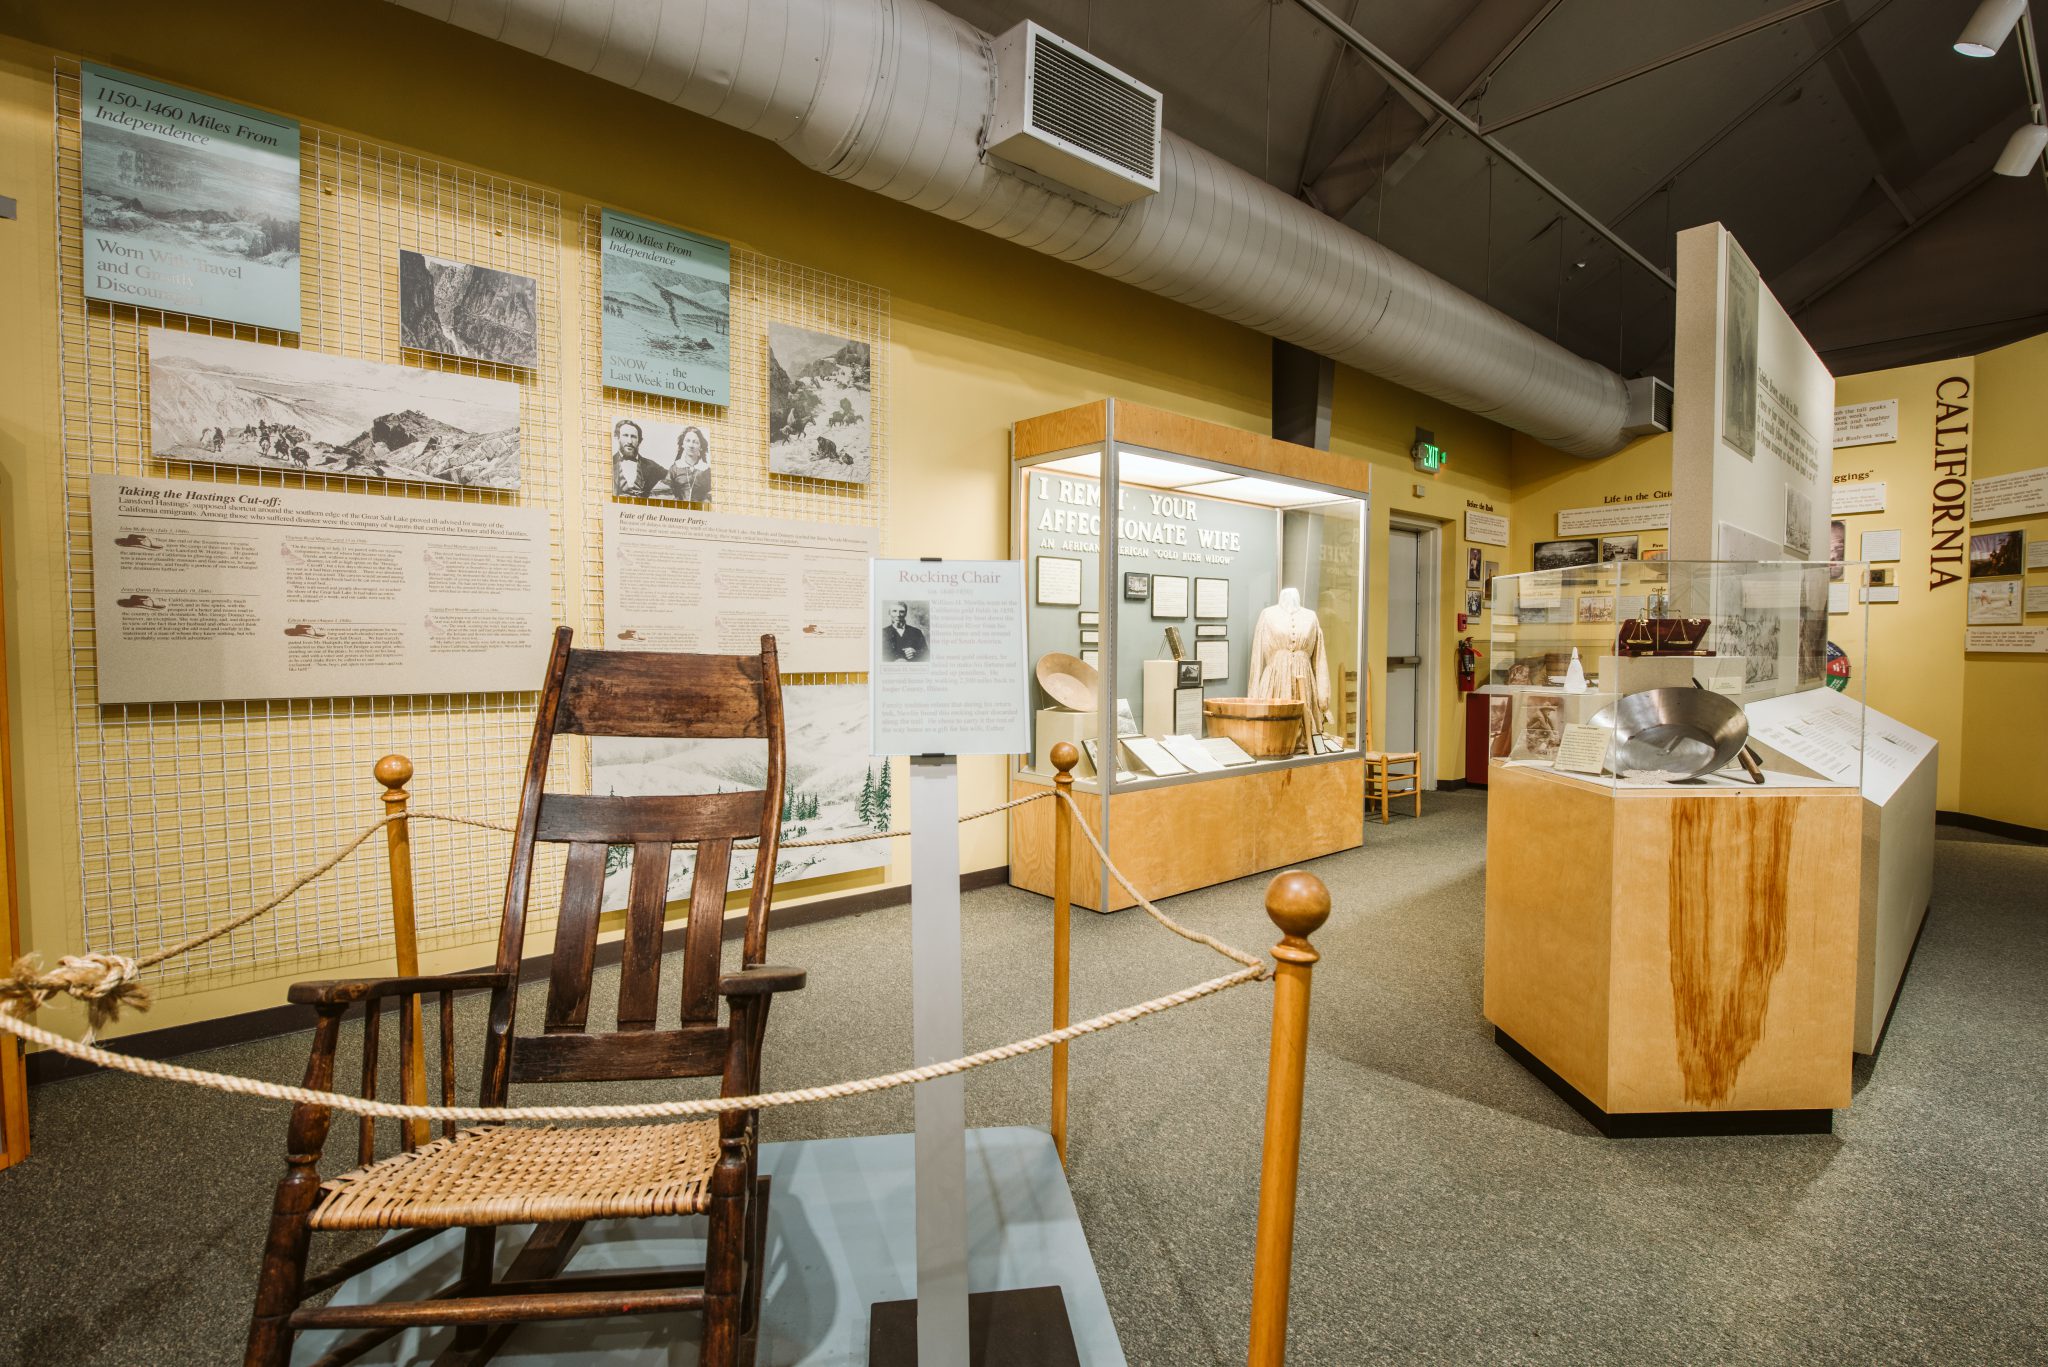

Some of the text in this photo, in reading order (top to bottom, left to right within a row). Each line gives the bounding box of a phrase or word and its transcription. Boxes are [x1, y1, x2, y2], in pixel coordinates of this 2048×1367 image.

[96, 105, 210, 146] Independence
[97, 88, 279, 147] 1150-1460 Miles From
[609, 241, 676, 266] Independence
[610, 226, 692, 257] 1800 Miles From
[96, 238, 144, 260] Worn
[192, 257, 242, 279] Travel
[96, 260, 129, 275] and
[610, 356, 648, 371] SNOW
[672, 367, 687, 379] the
[609, 368, 716, 397] Last Week in October
[1423, 443, 1439, 470] EXIT
[1833, 469, 1874, 484] ggings"
[1930, 376, 1970, 592] CALIFORNIA
[118, 485, 282, 508] Taking the Hastings Cut-off:
[1038, 477, 1049, 500] I
[1149, 494, 1198, 521] YOUR
[1604, 495, 1621, 504] Life
[1624, 494, 1633, 502] in
[1635, 492, 1649, 501] the
[118, 505, 158, 514] California
[619, 511, 708, 526] Fate of the Donner Party:
[1037, 507, 1241, 552] AFFECIONATE WIFE
[1040, 538, 1055, 549] AN
[1061, 540, 1100, 554] AFRICAN
[1119, 545, 1149, 558] ERICAN
[898, 569, 1001, 587] Rocking Chair
